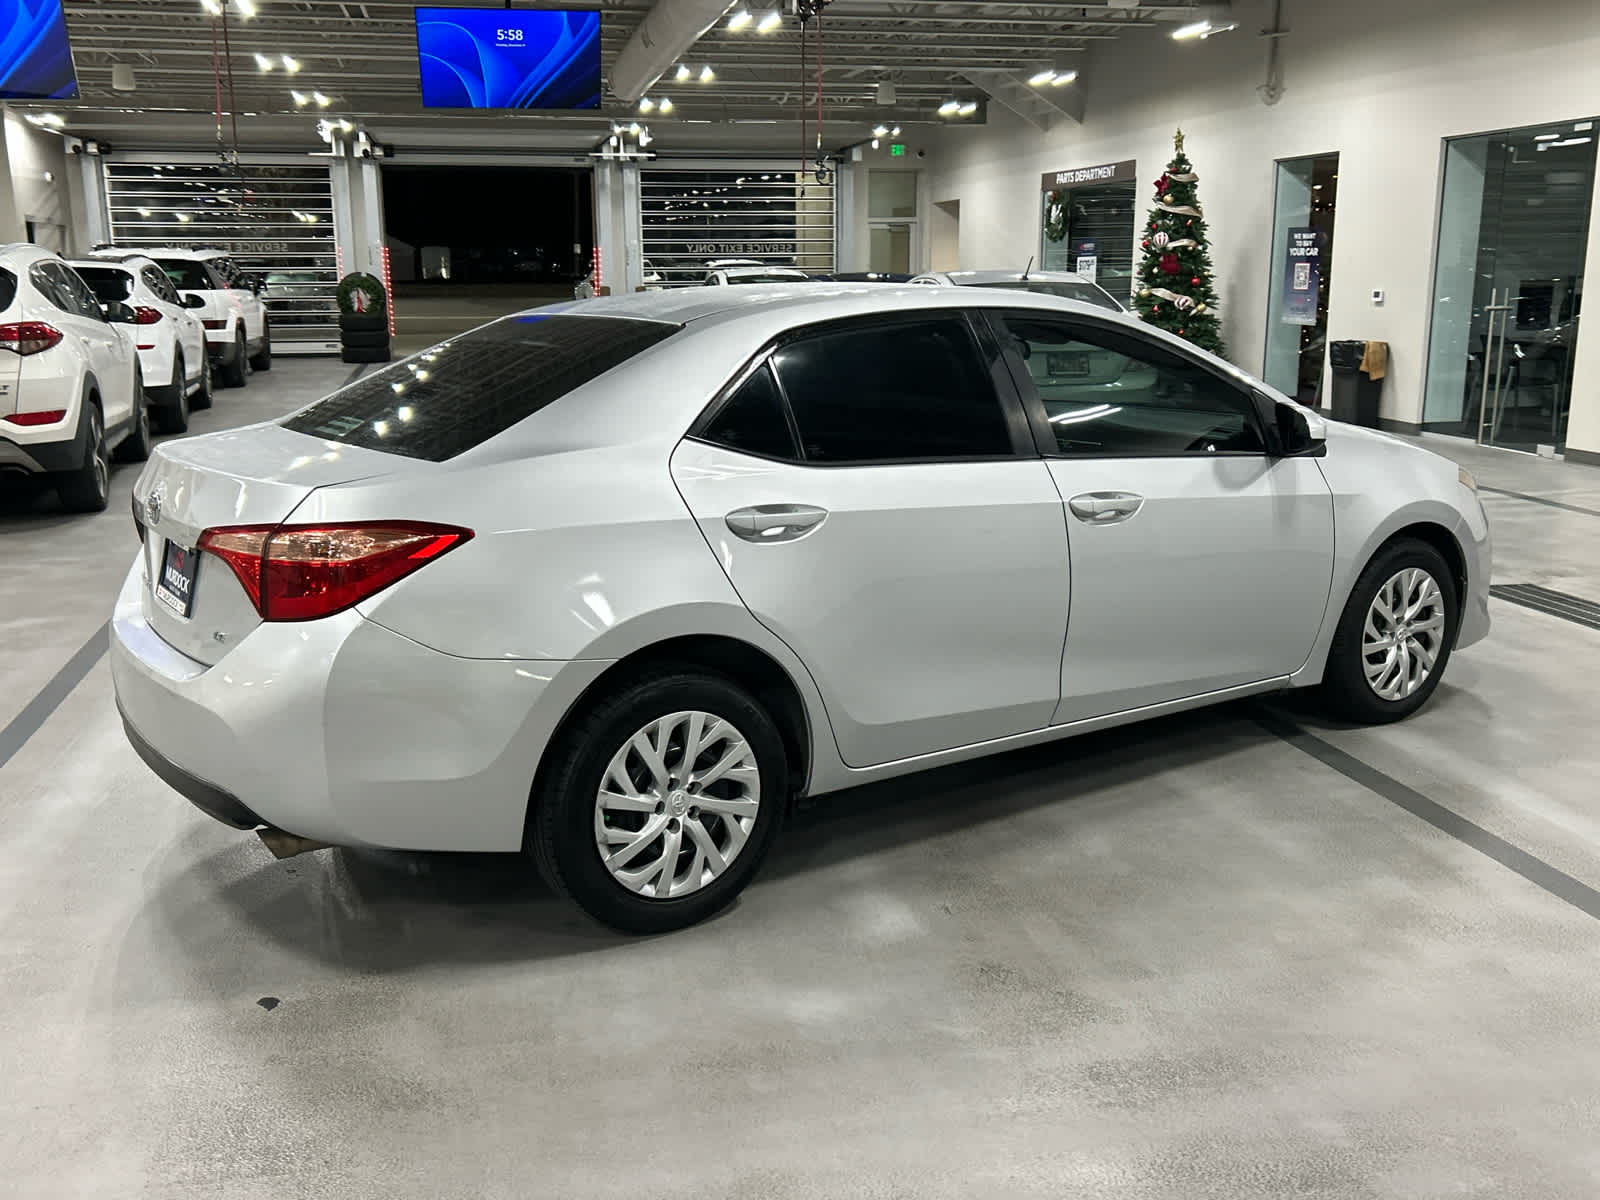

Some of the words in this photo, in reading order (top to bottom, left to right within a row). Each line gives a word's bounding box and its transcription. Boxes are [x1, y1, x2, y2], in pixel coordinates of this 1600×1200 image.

[497, 29, 523, 40] 5:58
[1056, 172, 1075, 184] PARTS
[1075, 165, 1117, 182] DEPARTMENT
[1289, 247, 1305, 256] YOUR
[1305, 247, 1319, 256] CAR
[165, 564, 190, 594] MURDOCK
